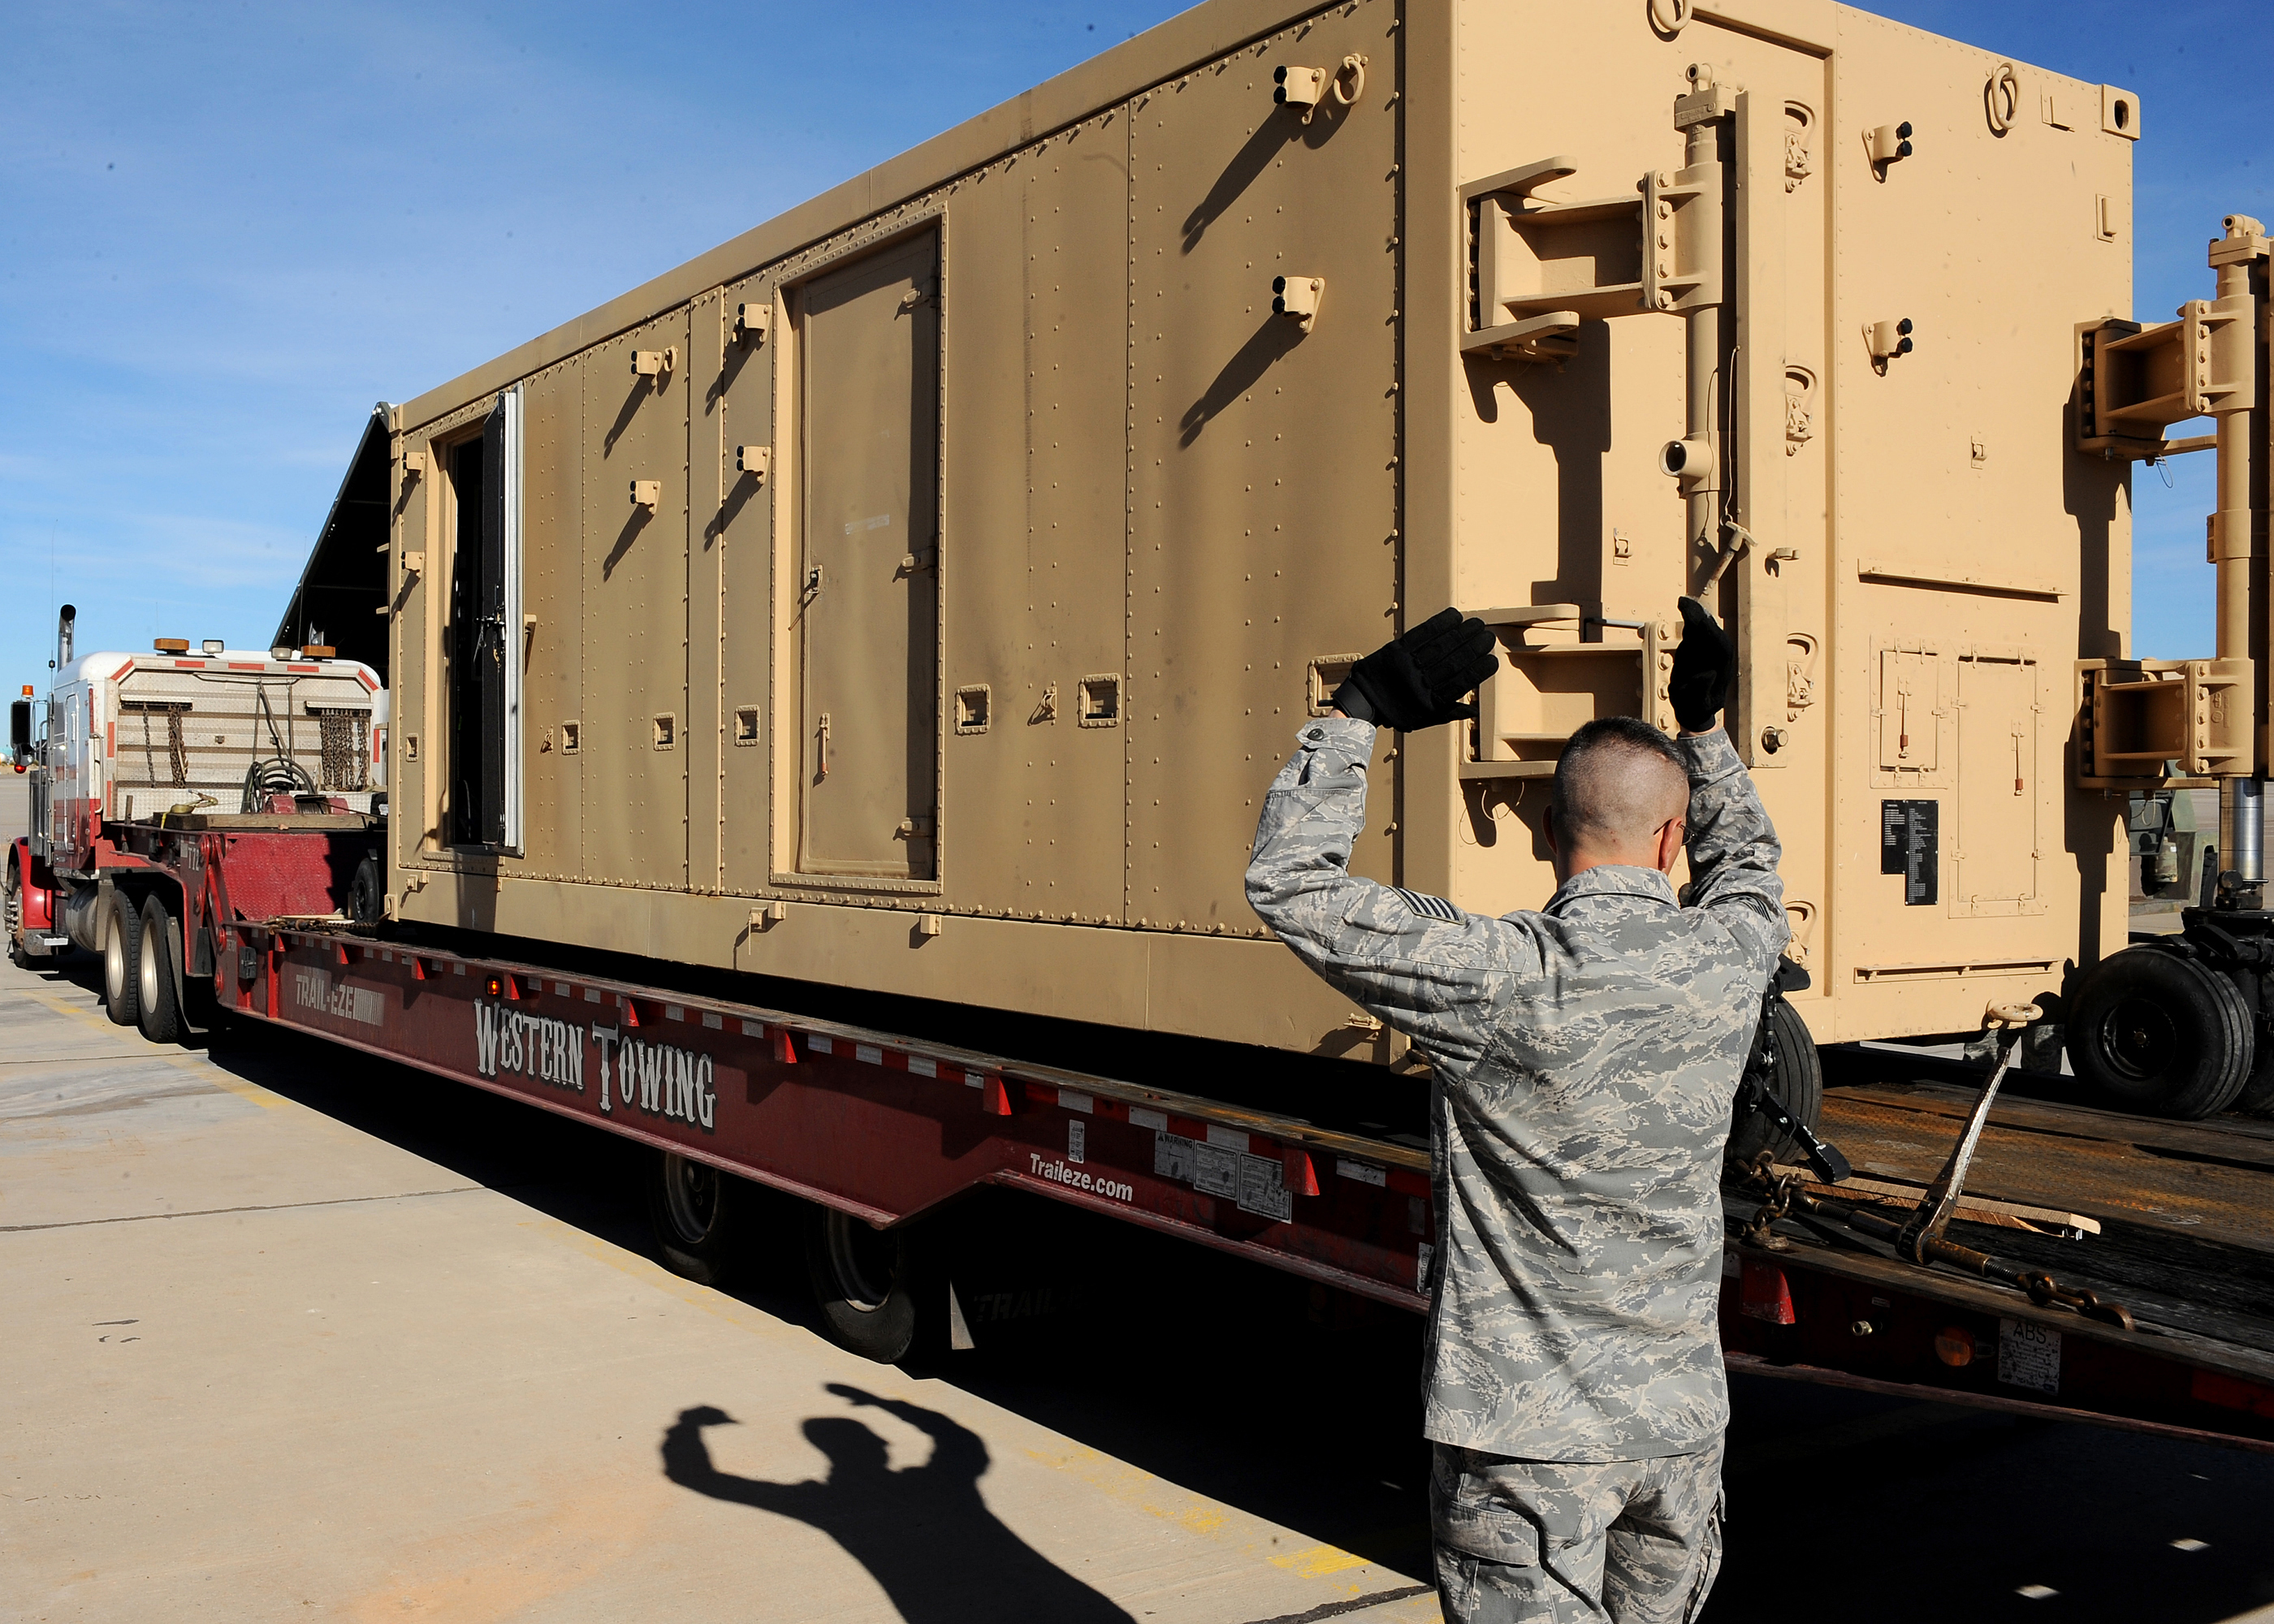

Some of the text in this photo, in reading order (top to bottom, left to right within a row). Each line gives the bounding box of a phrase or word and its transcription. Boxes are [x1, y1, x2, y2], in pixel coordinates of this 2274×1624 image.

[296, 974, 354, 1020] TRAIL-EZE
[473, 998, 716, 1129] WESTERN TOWING
[1164, 1133, 1193, 1149] WARNING
[1030, 1152, 1133, 1202] Traileze.com
[2013, 1321, 2047, 1345] ABS
